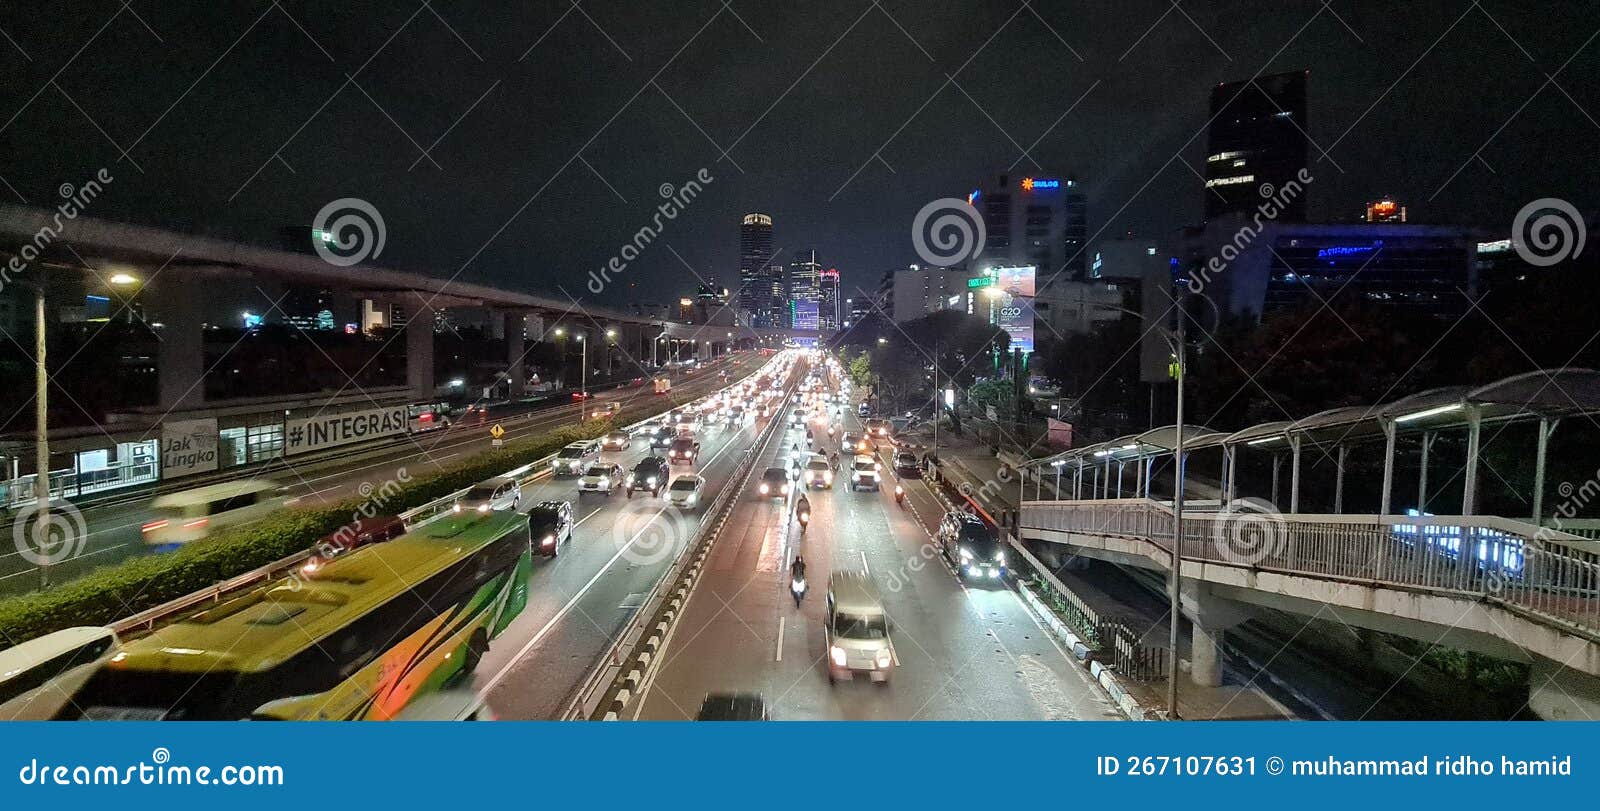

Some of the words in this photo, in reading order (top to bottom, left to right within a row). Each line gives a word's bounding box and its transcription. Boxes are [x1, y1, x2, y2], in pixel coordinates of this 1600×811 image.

[288, 410, 408, 447] #INTEGRASI
[163, 435, 192, 453] Jak
[163, 449, 215, 470] Lingko
